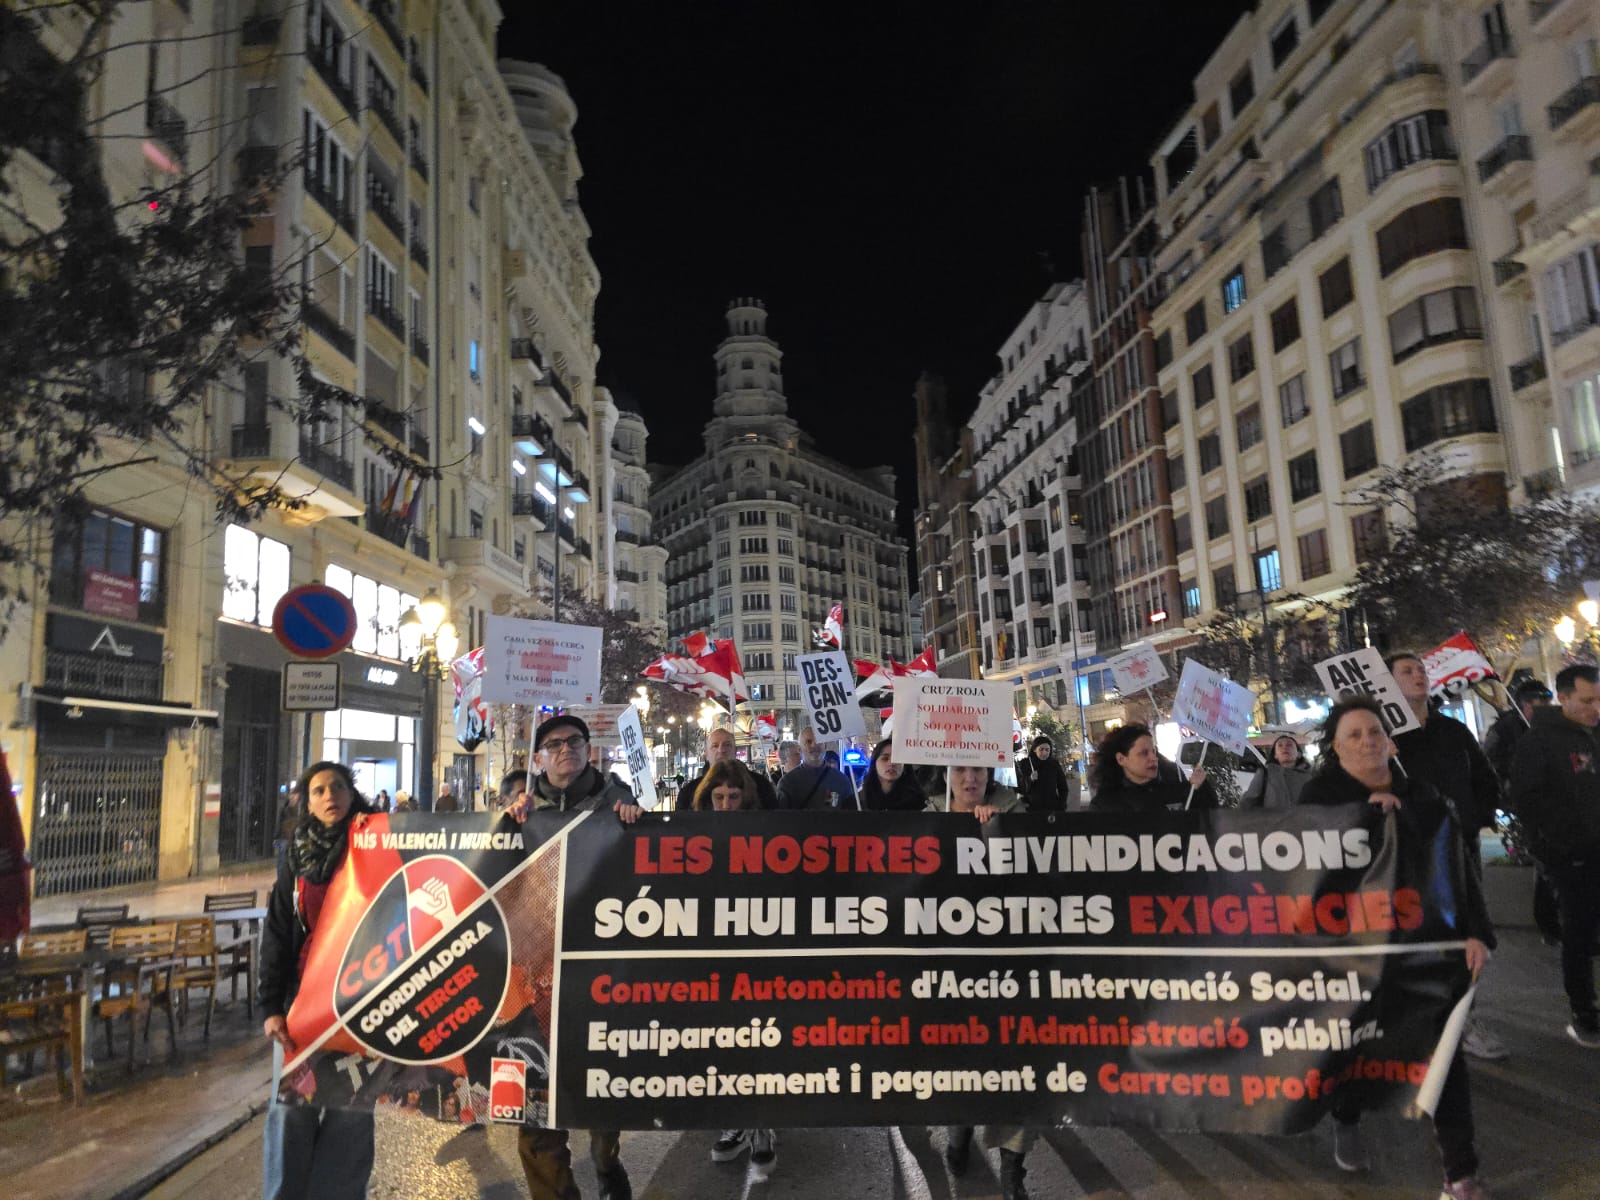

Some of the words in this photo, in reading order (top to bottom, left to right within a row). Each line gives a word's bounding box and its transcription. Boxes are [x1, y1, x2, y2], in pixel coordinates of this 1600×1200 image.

[504, 635, 525, 644] CADA
[561, 641, 585, 650] CERCA
[801, 658, 842, 685] DES-
[1327, 657, 1370, 690] AN-
[808, 681, 852, 710] CAN-
[921, 685, 954, 696] CRUZ
[956, 687, 985, 696] ROJA
[815, 708, 842, 735] SO
[917, 704, 989, 715] SOLIDARIDAD
[622, 725, 637, 751] VER-
[954, 722, 982, 732] PARA
[905, 738, 957, 749] RECOGER
[959, 741, 1000, 751] DINERO
[632, 776, 644, 799] ZA
[381, 827, 447, 850] VALENCIÀ
[450, 832, 457, 850] I
[459, 832, 524, 850] MURCIA
[635, 836, 713, 875] LES
[730, 835, 941, 874] NOSTRES
[956, 829, 1372, 875] REIVINDICACIONS
[594, 886, 699, 938] SÓN
[714, 897, 796, 937] HUI
[811, 896, 889, 935] LES
[904, 896, 1114, 935] NOSTRES
[1130, 883, 1424, 935] EXIGÈNCIES
[339, 922, 406, 997] CGT
[360, 920, 493, 1034] COORDINADORA
[591, 973, 720, 1004] Conveni
[732, 971, 901, 1001] Autonòmic
[912, 970, 1019, 999] d'Acció
[1030, 970, 1040, 999] i
[1050, 971, 1240, 1002] Intervenció
[1251, 970, 1372, 1002] Social.
[385, 1013, 420, 1046] DEL
[415, 963, 479, 1019] TERCER
[418, 996, 484, 1054] SECTOR
[587, 1018, 782, 1058] Equiparació
[792, 1016, 910, 1046] salarial
[921, 1016, 989, 1045] amb
[1000, 1016, 1249, 1048] l'Administració
[586, 1065, 841, 1098] Reconeixement
[851, 1063, 861, 1093] i
[872, 1066, 1036, 1100] pagament
[1046, 1063, 1088, 1093] de
[1097, 1063, 1230, 1097] Carrera
[1242, 1056, 1431, 1105] profiona
[493, 1103, 523, 1120] CGT
